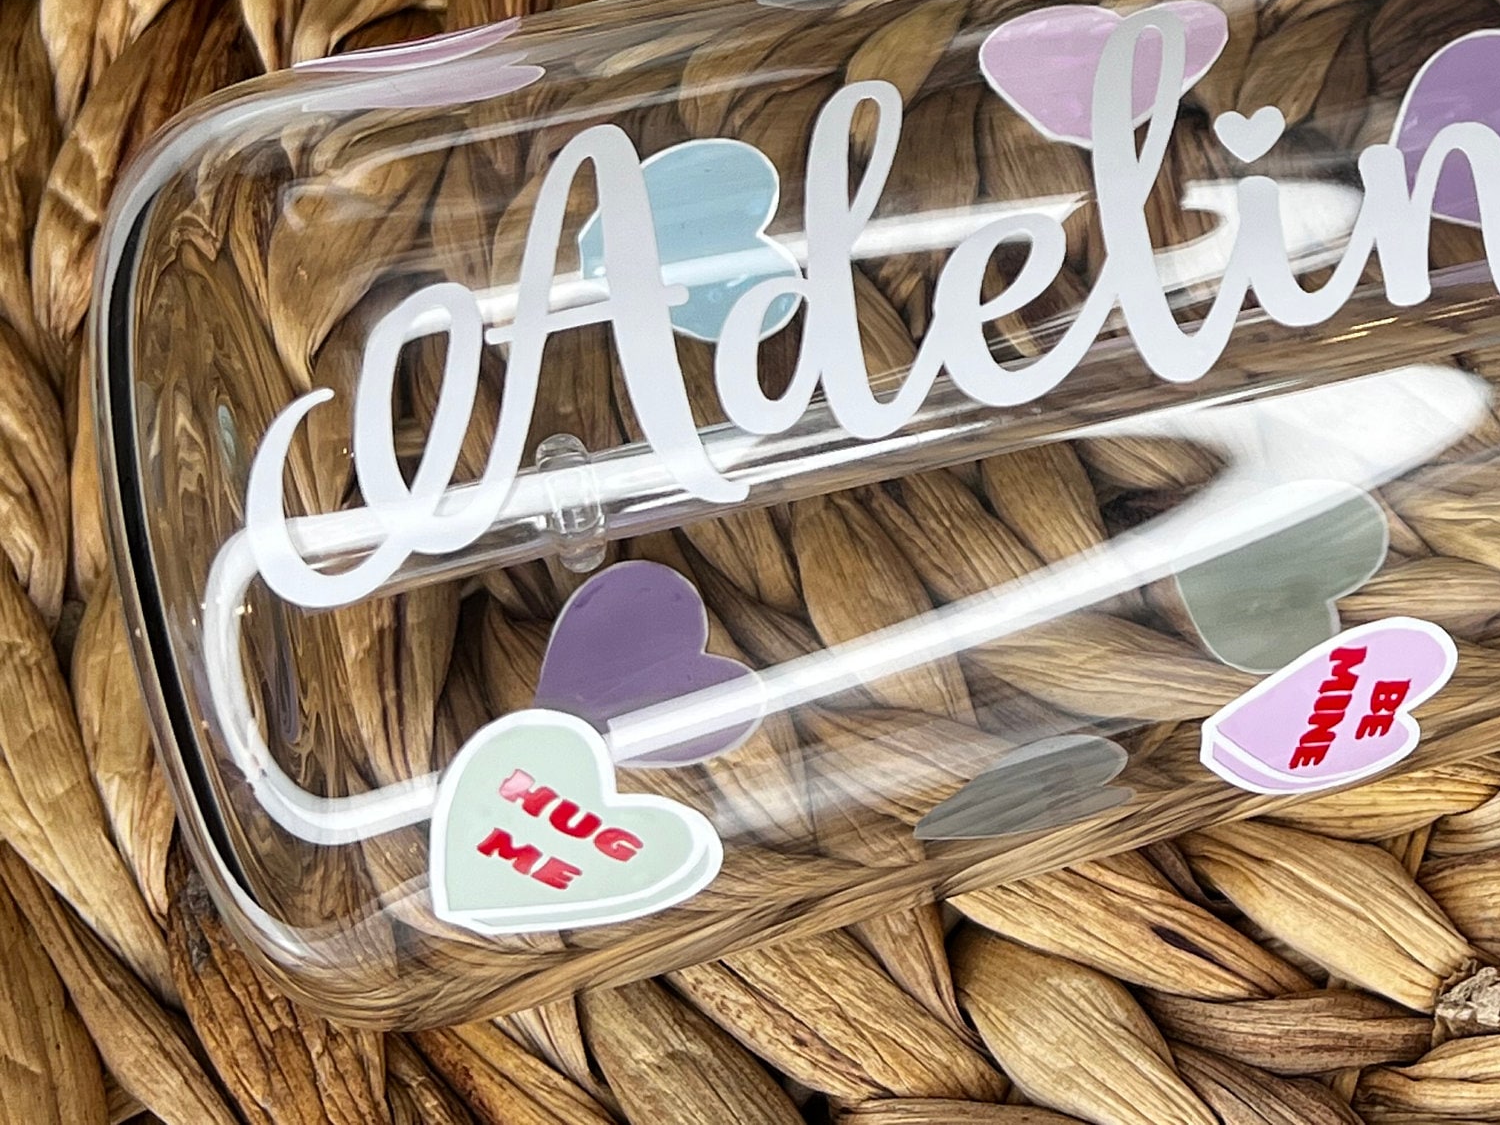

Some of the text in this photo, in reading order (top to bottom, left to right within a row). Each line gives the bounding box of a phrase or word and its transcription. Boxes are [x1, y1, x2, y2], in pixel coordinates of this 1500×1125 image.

[1288, 645, 1368, 770] MINE
[1354, 678, 1411, 740] BE
[499, 768, 644, 862] HUG
[476, 827, 583, 891] ME
